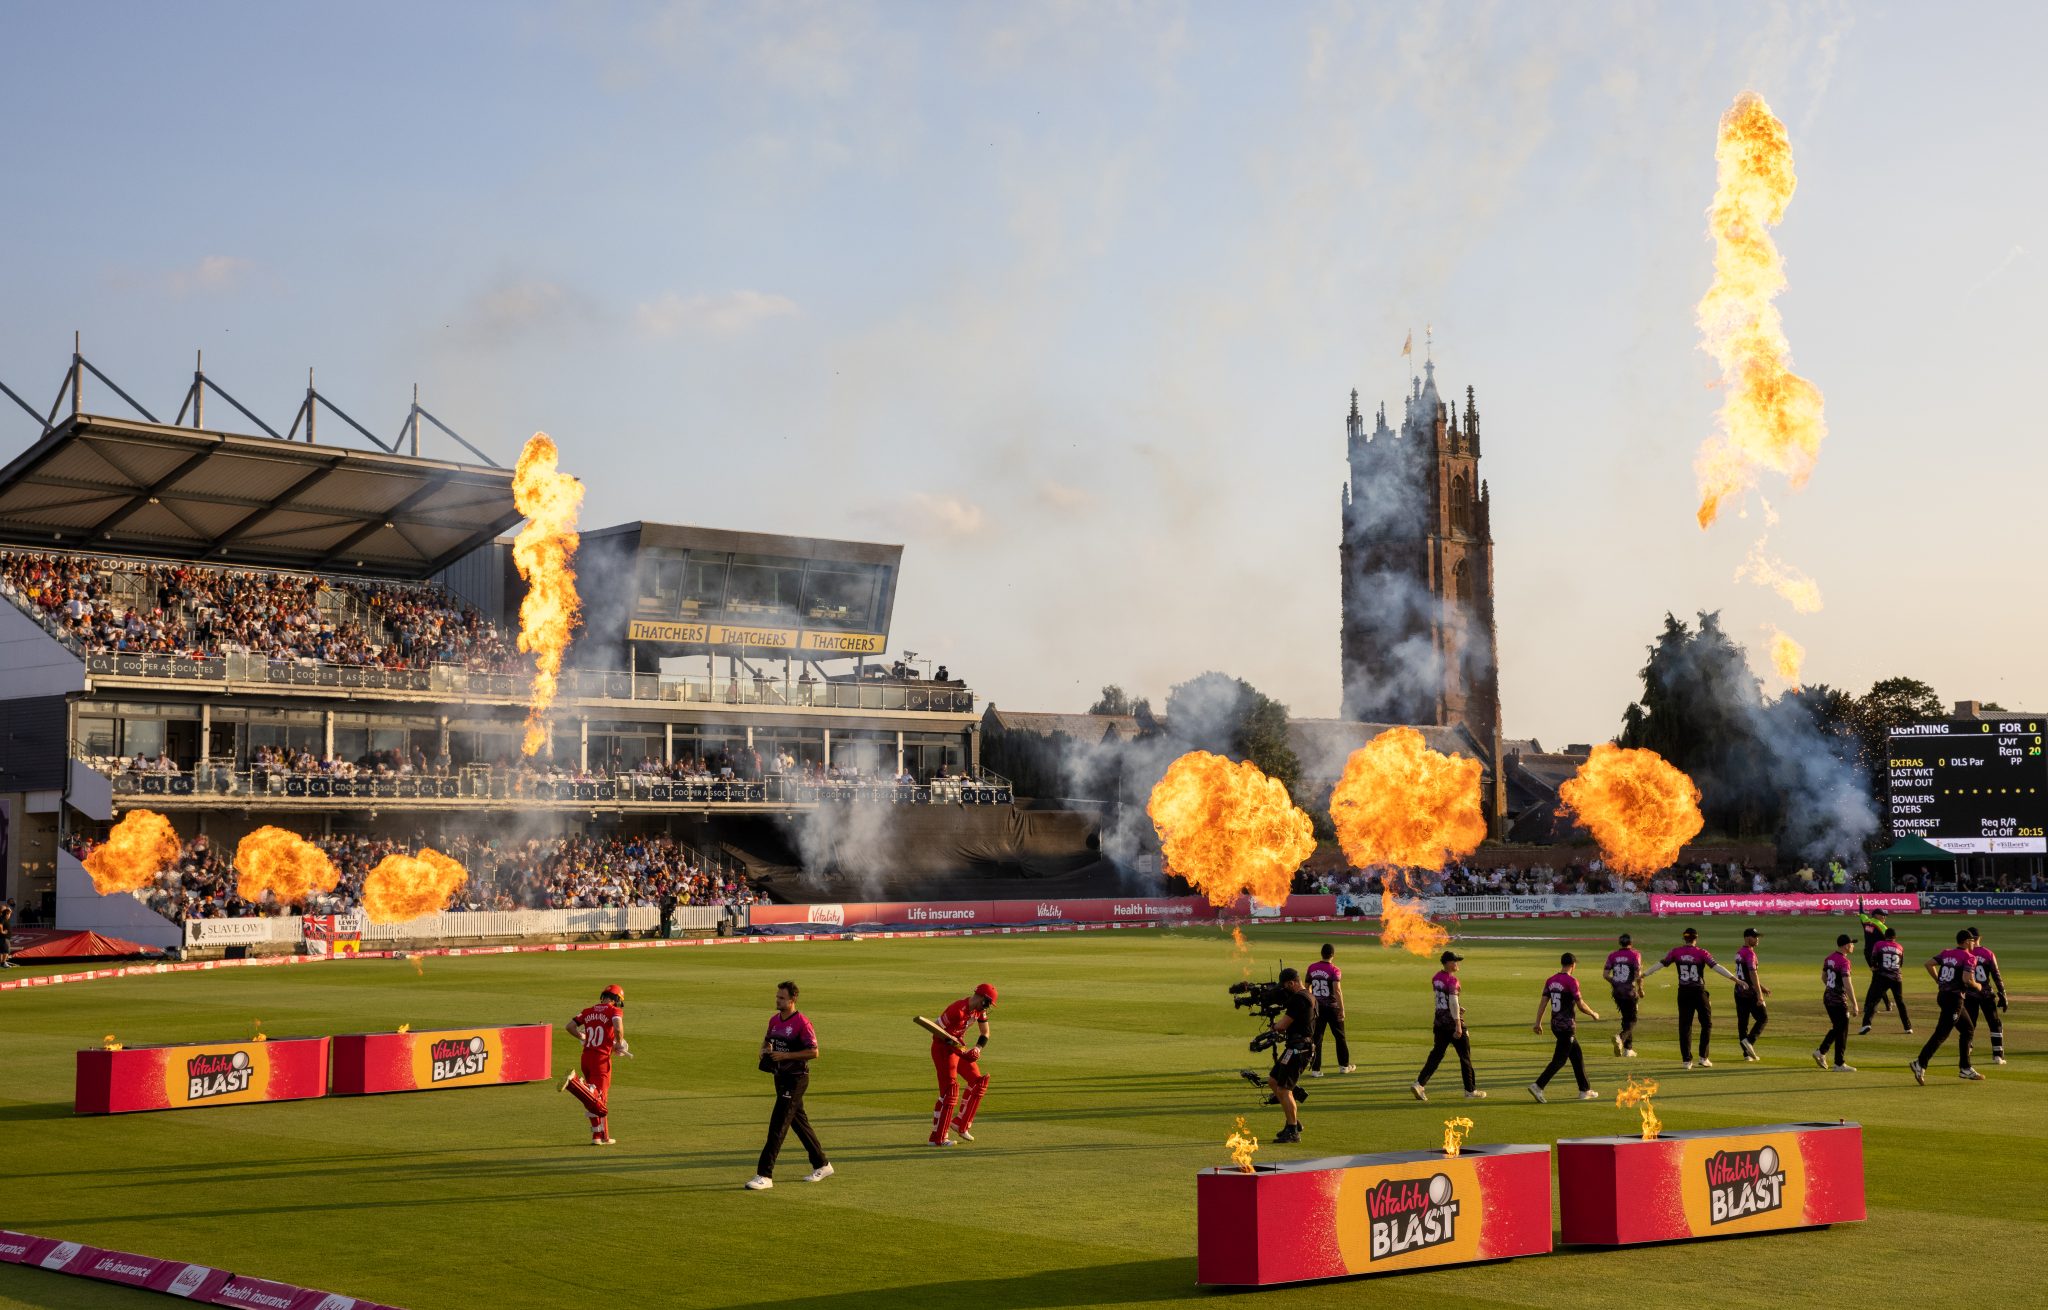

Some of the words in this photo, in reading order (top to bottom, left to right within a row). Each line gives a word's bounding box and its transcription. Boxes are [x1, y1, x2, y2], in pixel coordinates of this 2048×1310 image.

[101, 559, 147, 571] COOPER
[634, 623, 703, 641] THATCHERS
[721, 628, 787, 646] THATCHERS
[812, 634, 875, 650] THATCHERS
[93, 659, 107, 669] CA
[123, 662, 158, 671] COOPER
[160, 664, 214, 674] ASSOCIATES
[272, 669, 285, 679] CA
[296, 671, 333, 680] COOPER
[346, 674, 403, 685] ASSOCIATES
[413, 677, 426, 686] CA
[612, 681, 623, 691] CA
[912, 696, 922, 704] CA
[934, 697, 944, 705] CA
[1890, 724, 1949, 735] LIGHTNING
[1982, 724, 1990, 733] 0
[2000, 723, 2022, 733] FOR
[2029, 722, 2037, 732] 0
[2034, 736, 2042, 745] 0
[1999, 747, 2023, 756] Rem
[2028, 747, 2042, 756] 20
[1890, 759, 1924, 768] EXTRAS
[1938, 758, 1946, 767] 0
[1951, 758, 1968, 767] DLS
[1969, 758, 1985, 767] Par
[2010, 757, 2023, 766] PP
[1890, 768, 1911, 777] LAST
[1913, 768, 1934, 777] WKT
[118, 780, 133, 791] CA
[146, 780, 160, 791] CA
[174, 780, 189, 791] CA
[288, 782, 302, 791] CA
[311, 782, 325, 792] CA
[421, 785, 434, 793] CA
[1891, 779, 1913, 787] HOW
[1914, 778, 1934, 787] OUT
[559, 785, 570, 795] CA
[580, 785, 591, 796] CA
[600, 785, 611, 796] CA
[654, 788, 666, 797] CA
[703, 789, 745, 797] ASSOCIATES
[750, 789, 761, 798] CA
[917, 792, 927, 800] CA
[963, 792, 974, 801] CA
[980, 792, 991, 801] CA
[997, 793, 1007, 801] CA
[1892, 795, 1935, 804] BOWLERS
[1892, 806, 1922, 814] OVERS
[1892, 819, 1940, 828] SOMERSET
[1981, 818, 1999, 828] Req
[2000, 818, 2017, 827] R/R
[1893, 829, 1906, 838] TO
[1981, 828, 1998, 837] Cut
[1999, 828, 2014, 837] Off
[2018, 827, 2044, 837] 20:15
[1660, 899, 1702, 909] Preferred
[1703, 900, 1729, 909] Legal
[1822, 898, 1854, 907] County
[1856, 898, 1889, 906] Cricket
[1890, 897, 1912, 906] Club
[1939, 896, 1960, 905] One
[1962, 896, 1984, 907] Step
[1986, 896, 2047, 906] Recruitment
[811, 907, 842, 924] Vitality
[908, 908, 927, 920] Life
[928, 908, 975, 919] insurance
[1037, 902, 1063, 919] Vitality
[1113, 903, 1144, 916] Health
[207, 923, 241, 934] SUAVE
[1680, 964, 1699, 981] 54
[1311, 979, 1330, 997] 25
[432, 1041, 470, 1060] Vitality
[189, 1055, 232, 1077] Vitality
[433, 1052, 487, 1082] BLAST
[189, 1068, 251, 1099] BLAST
[1708, 1152, 1760, 1187] Vitality
[1369, 1182, 1430, 1219] Vitality
[1712, 1174, 1784, 1222] BLAST
[1373, 1203, 1457, 1258] BLAST
[0, 1243, 26, 1256] urance
[94, 1257, 114, 1272] Life
[112, 1260, 152, 1278] insurance
[219, 1283, 252, 1301] Health
[250, 1290, 292, 1309] insurance
